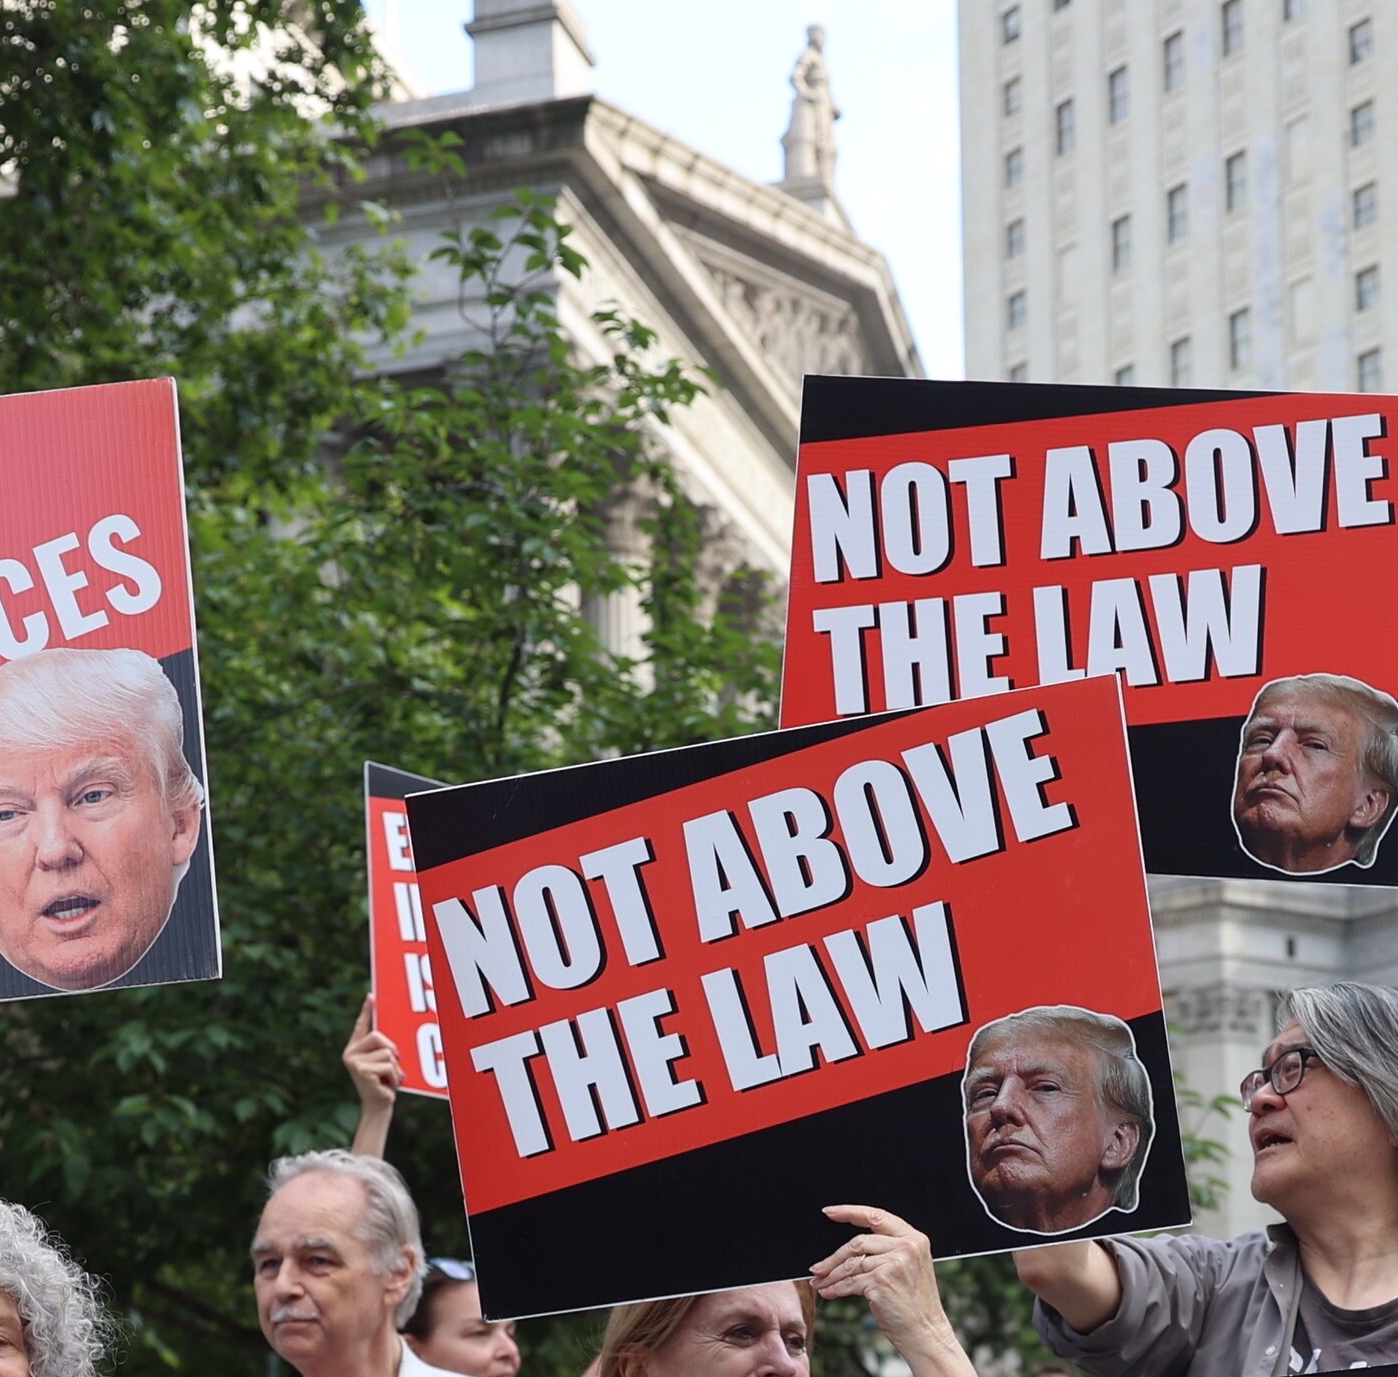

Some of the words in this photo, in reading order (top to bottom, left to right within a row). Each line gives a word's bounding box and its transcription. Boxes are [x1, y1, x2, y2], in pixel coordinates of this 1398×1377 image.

[807, 454, 1014, 584] NOT
[1041, 412, 1392, 561] ABOVE
[812, 591, 1010, 716] THE
[1033, 564, 1263, 688] LAW
[433, 836, 663, 1020] NOT
[682, 708, 1075, 944] ABOVE
[470, 990, 704, 1159] THE
[700, 901, 967, 1093] LAW
